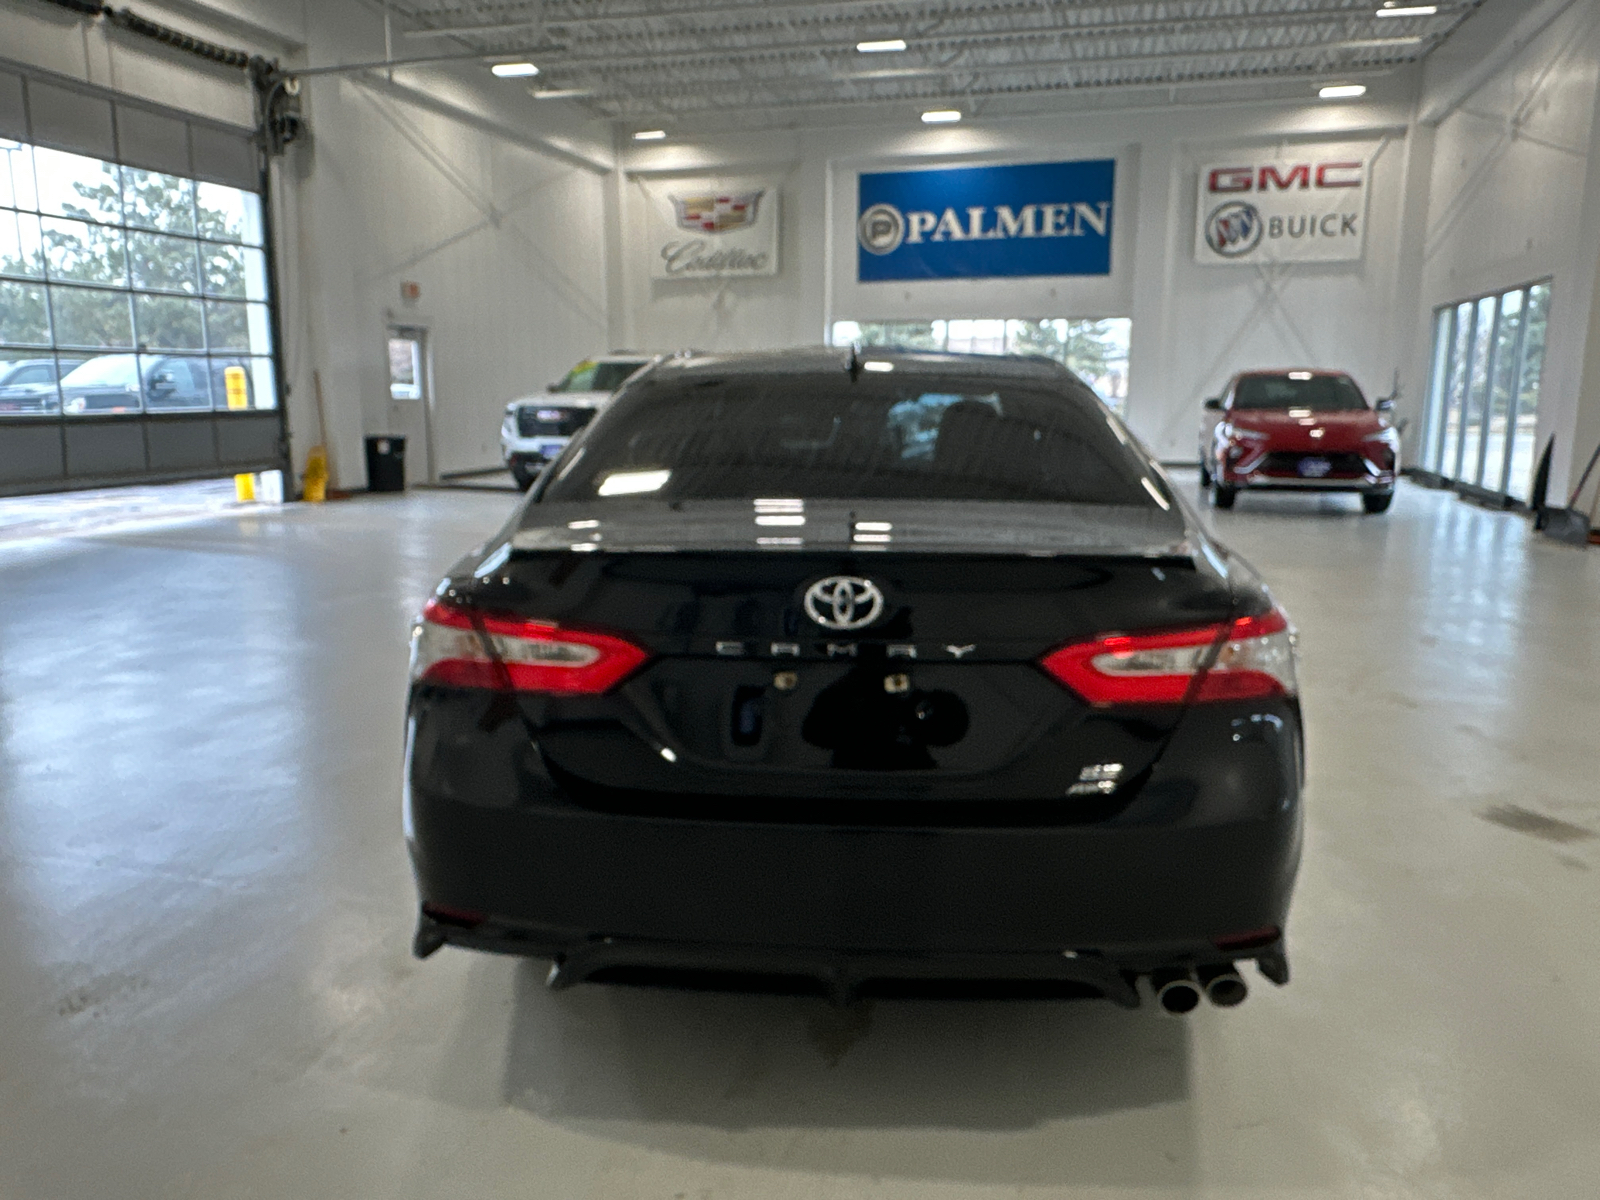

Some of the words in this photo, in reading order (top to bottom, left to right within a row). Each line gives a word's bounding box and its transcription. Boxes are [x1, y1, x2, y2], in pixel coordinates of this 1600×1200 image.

[1208, 162, 1363, 193] GMC
[904, 201, 1112, 245] PALMEN
[1268, 212, 1359, 239] BUICK
[715, 640, 977, 659] CAMRY
